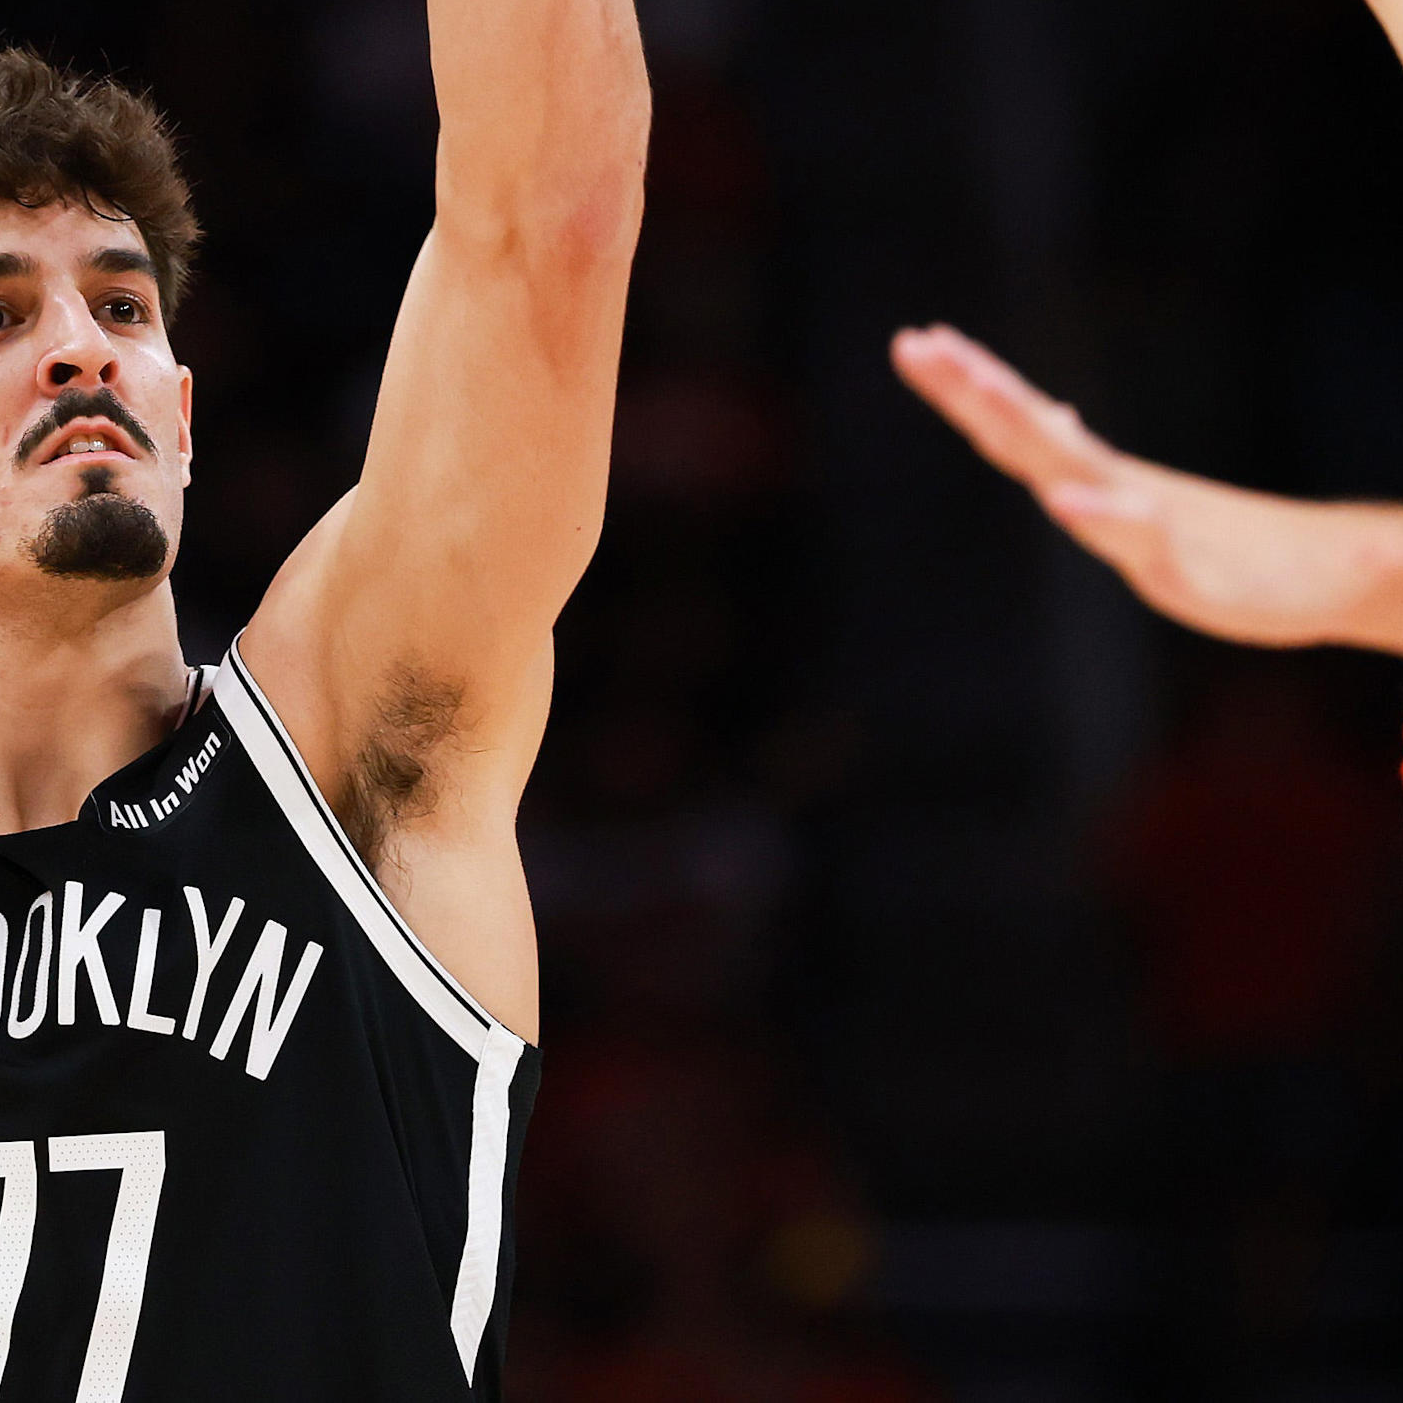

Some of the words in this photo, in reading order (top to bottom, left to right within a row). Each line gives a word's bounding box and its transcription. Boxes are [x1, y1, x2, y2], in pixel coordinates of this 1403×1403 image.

[109, 800, 150, 829] All
[149, 791, 181, 822] In
[174, 731, 222, 795] Won
